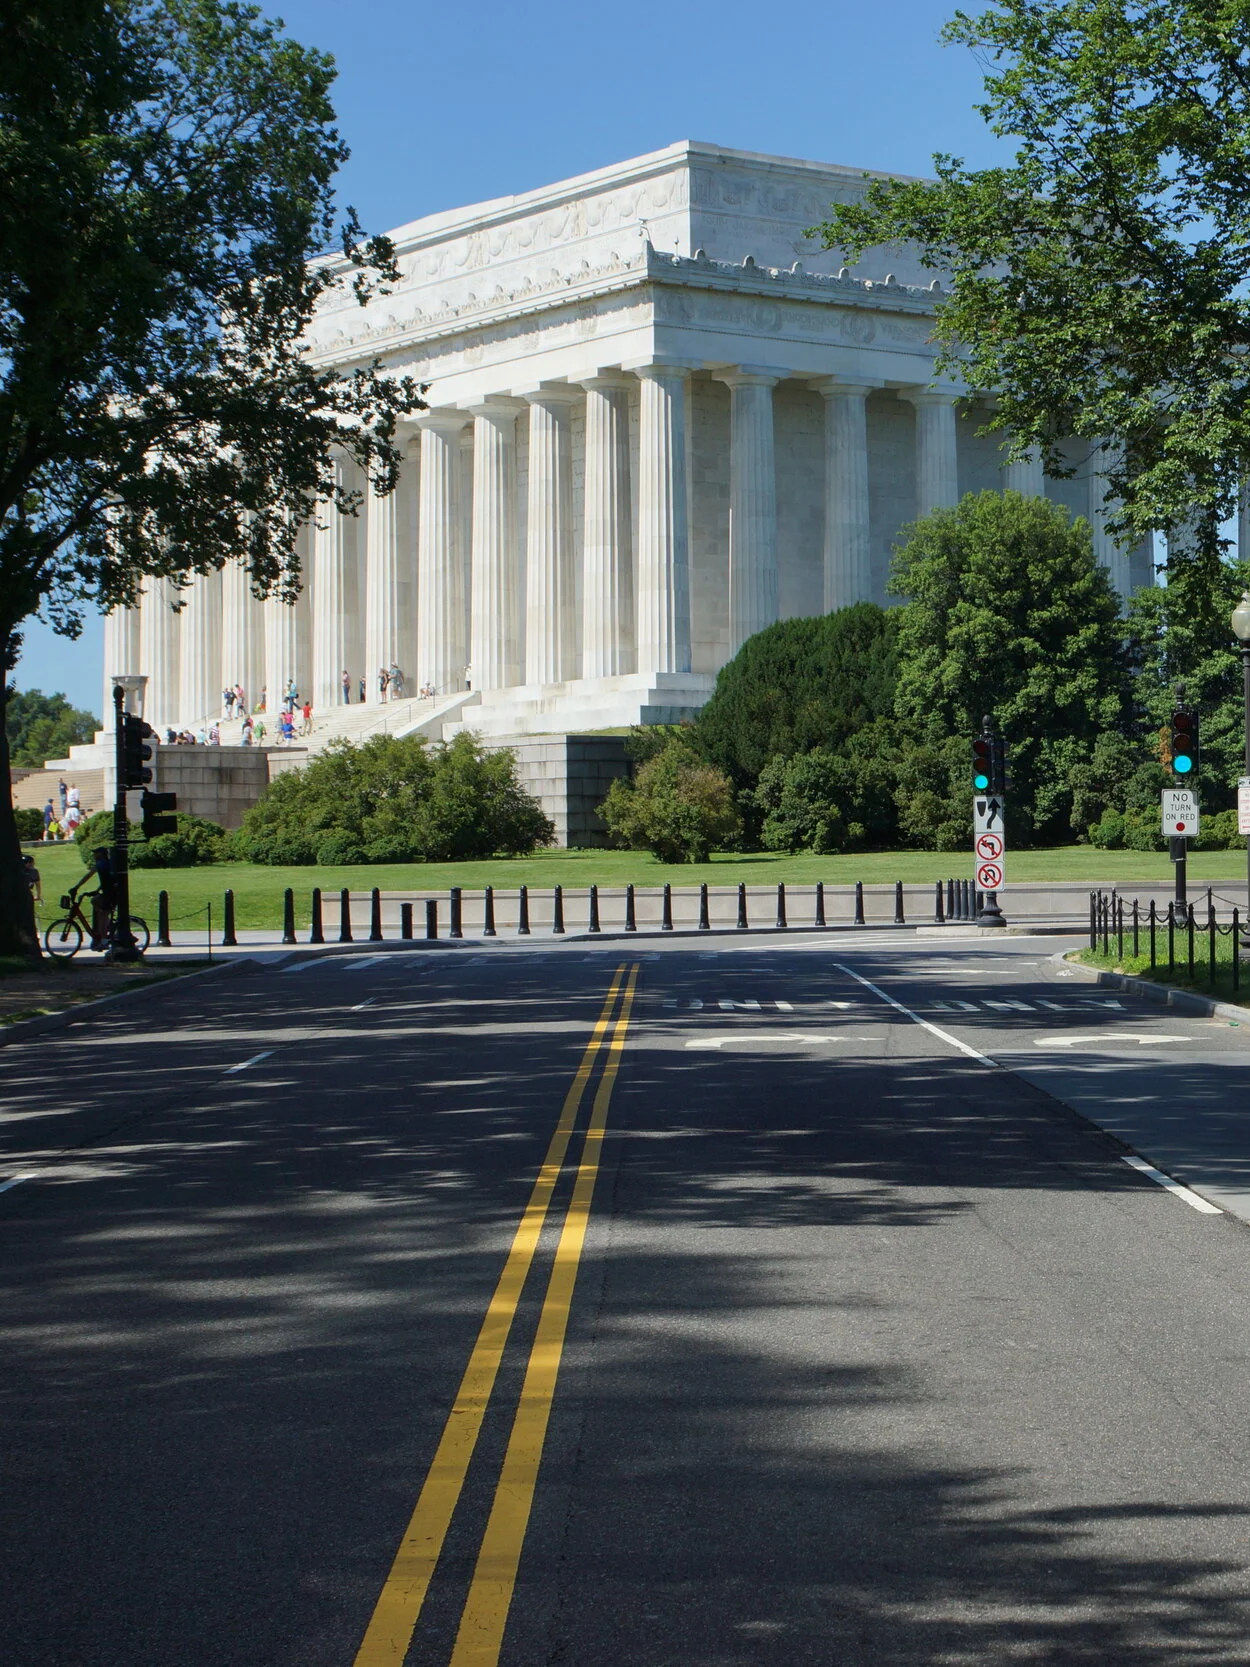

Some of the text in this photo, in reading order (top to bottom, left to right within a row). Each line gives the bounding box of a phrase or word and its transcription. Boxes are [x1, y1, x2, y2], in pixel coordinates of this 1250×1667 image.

[1172, 793, 1188, 802] NO
[1171, 803, 1192, 812] TURN
[1165, 813, 1196, 821] ON RED
